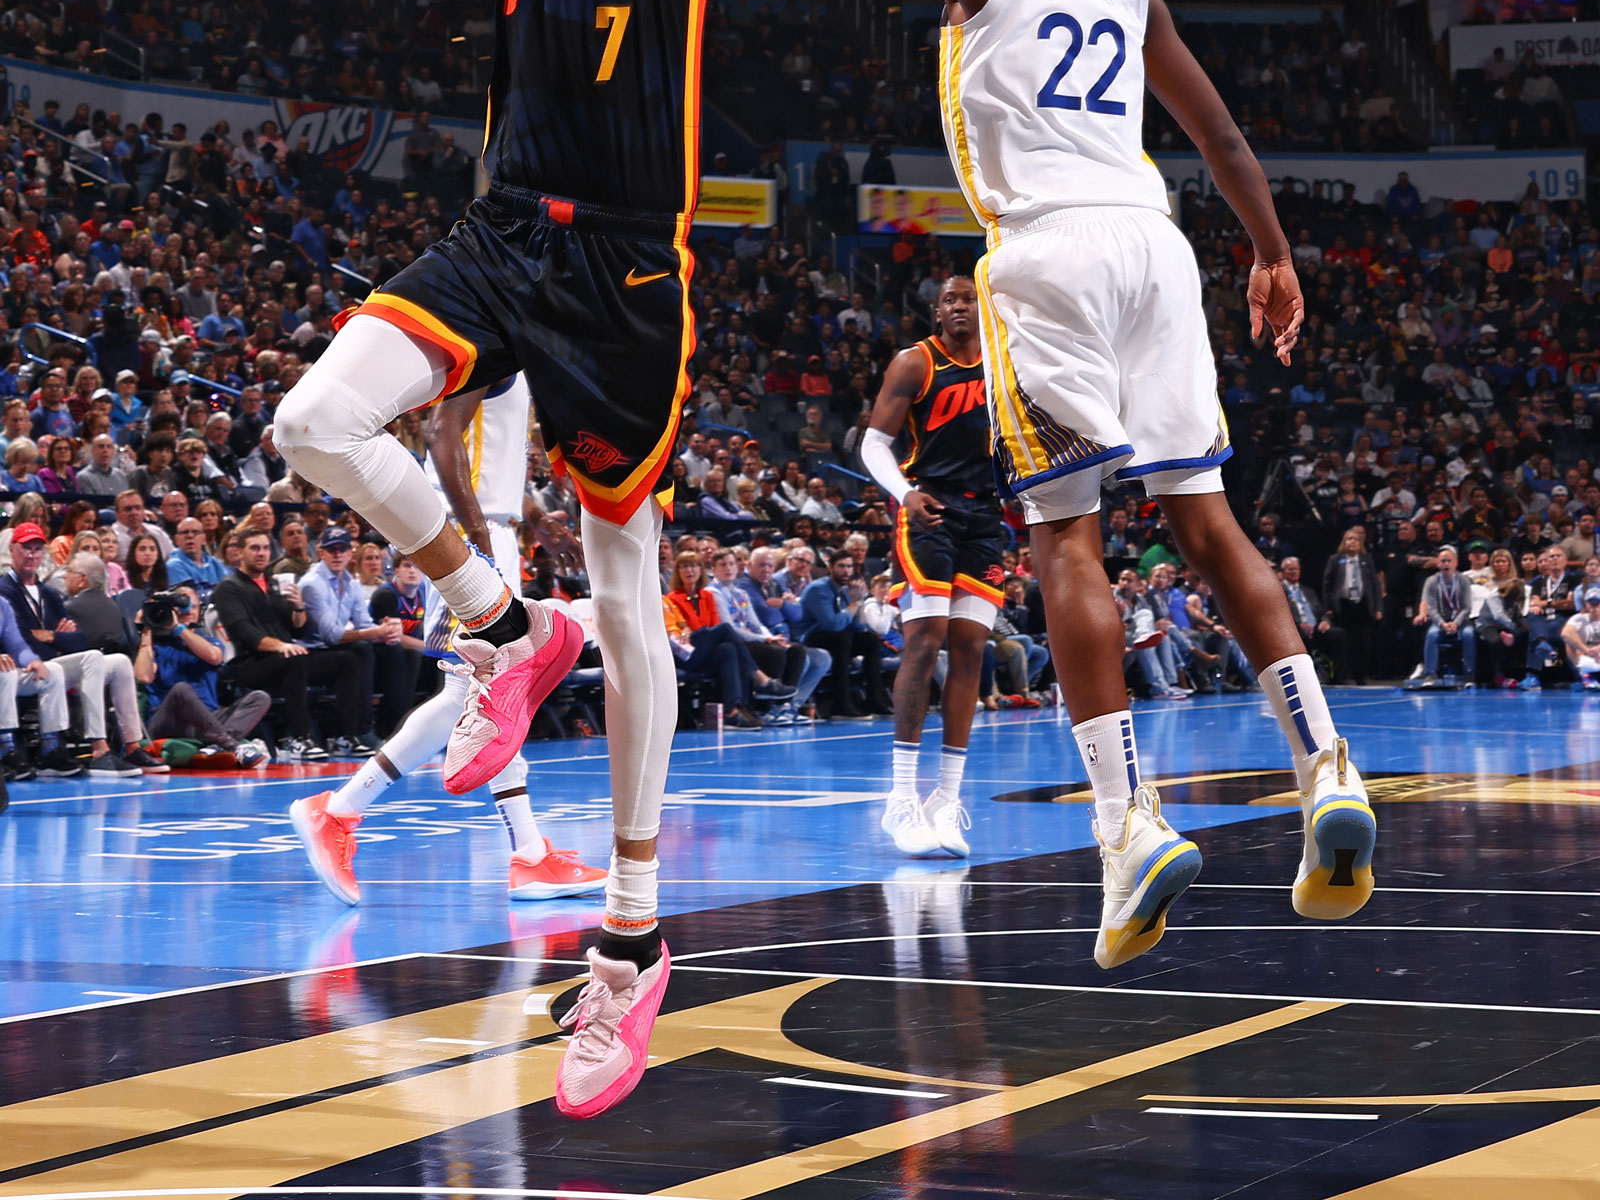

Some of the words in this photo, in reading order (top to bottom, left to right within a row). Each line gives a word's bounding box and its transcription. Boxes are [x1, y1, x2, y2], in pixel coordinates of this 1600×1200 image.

[595, 5, 631, 83] 7
[1036, 11, 1127, 117] 22
[285, 105, 369, 155] OKC
[1527, 167, 1580, 198] 109
[926, 378, 986, 433] OK
[92, 799, 486, 838] ceter
